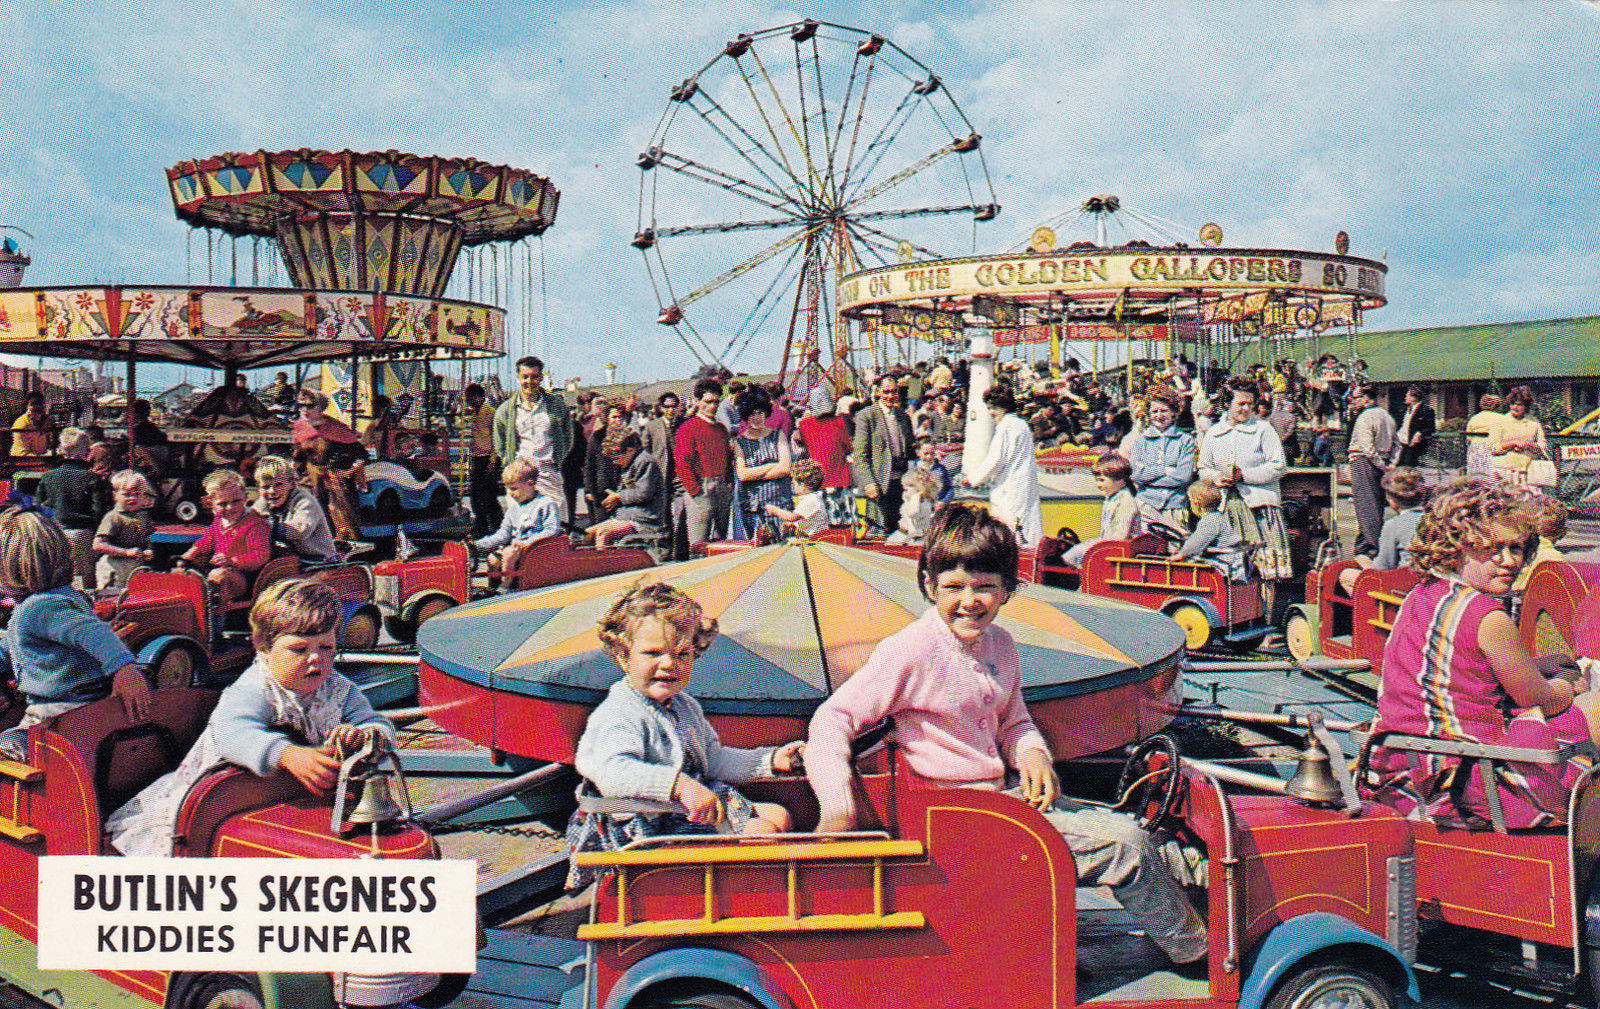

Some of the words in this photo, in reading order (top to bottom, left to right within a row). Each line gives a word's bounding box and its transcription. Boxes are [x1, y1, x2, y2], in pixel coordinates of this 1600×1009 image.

[869, 274, 891, 297] ON
[904, 267, 951, 292] THE
[974, 257, 1109, 287] GOLDEN
[1130, 256, 1302, 284] GALLOPERS
